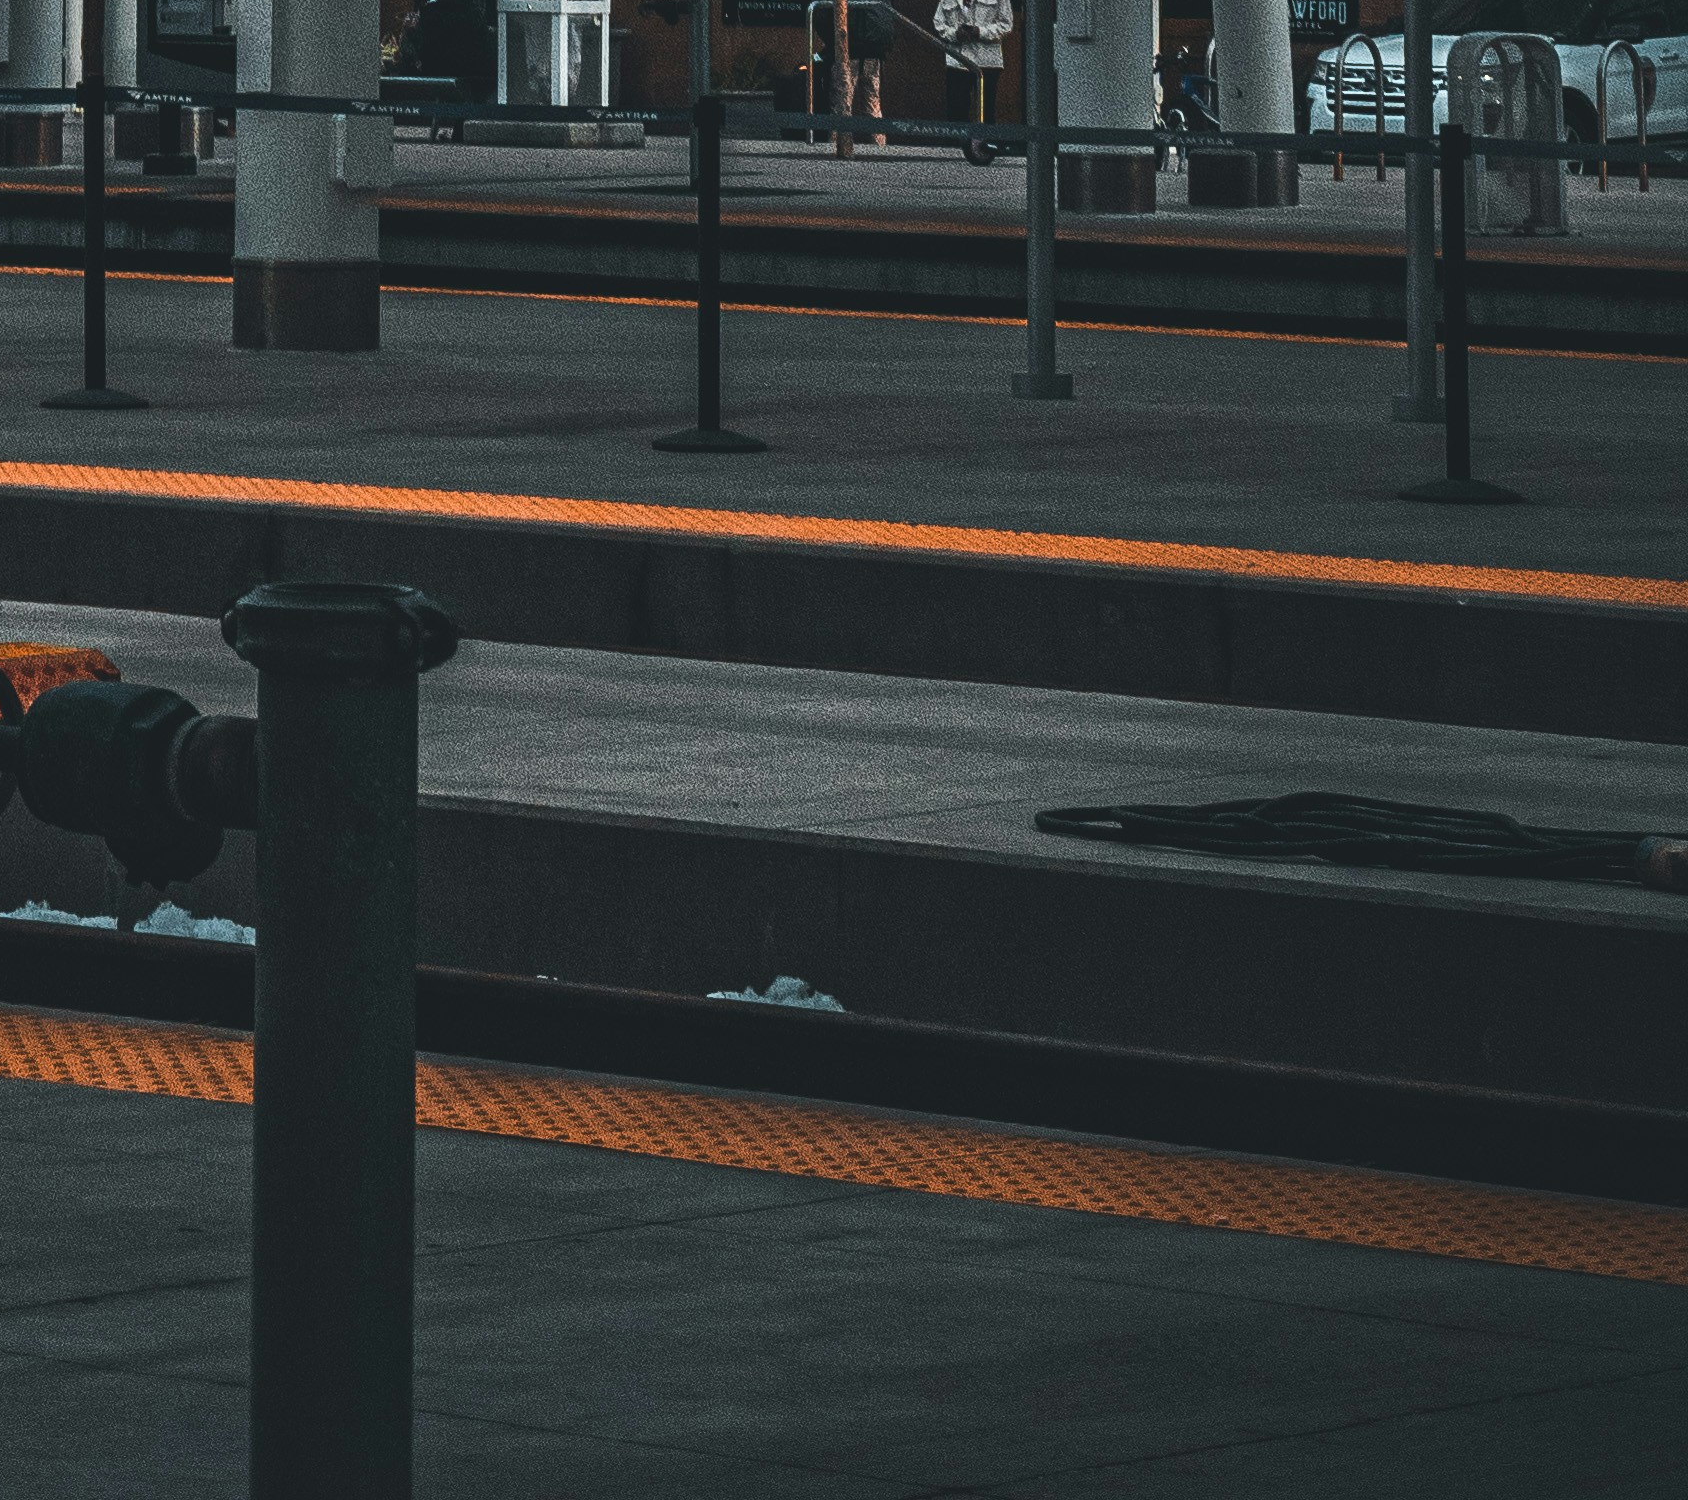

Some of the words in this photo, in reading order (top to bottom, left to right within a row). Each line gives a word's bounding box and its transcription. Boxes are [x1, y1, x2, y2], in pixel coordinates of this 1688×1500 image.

[737, 1, 765, 10] UNION
[767, 2, 802, 11] STATION
[1290, 0, 1347, 25] WFORD
[144, 93, 193, 103] AMTRAK
[369, 104, 420, 115] AMTRAK
[605, 110, 658, 120] AMTRAK
